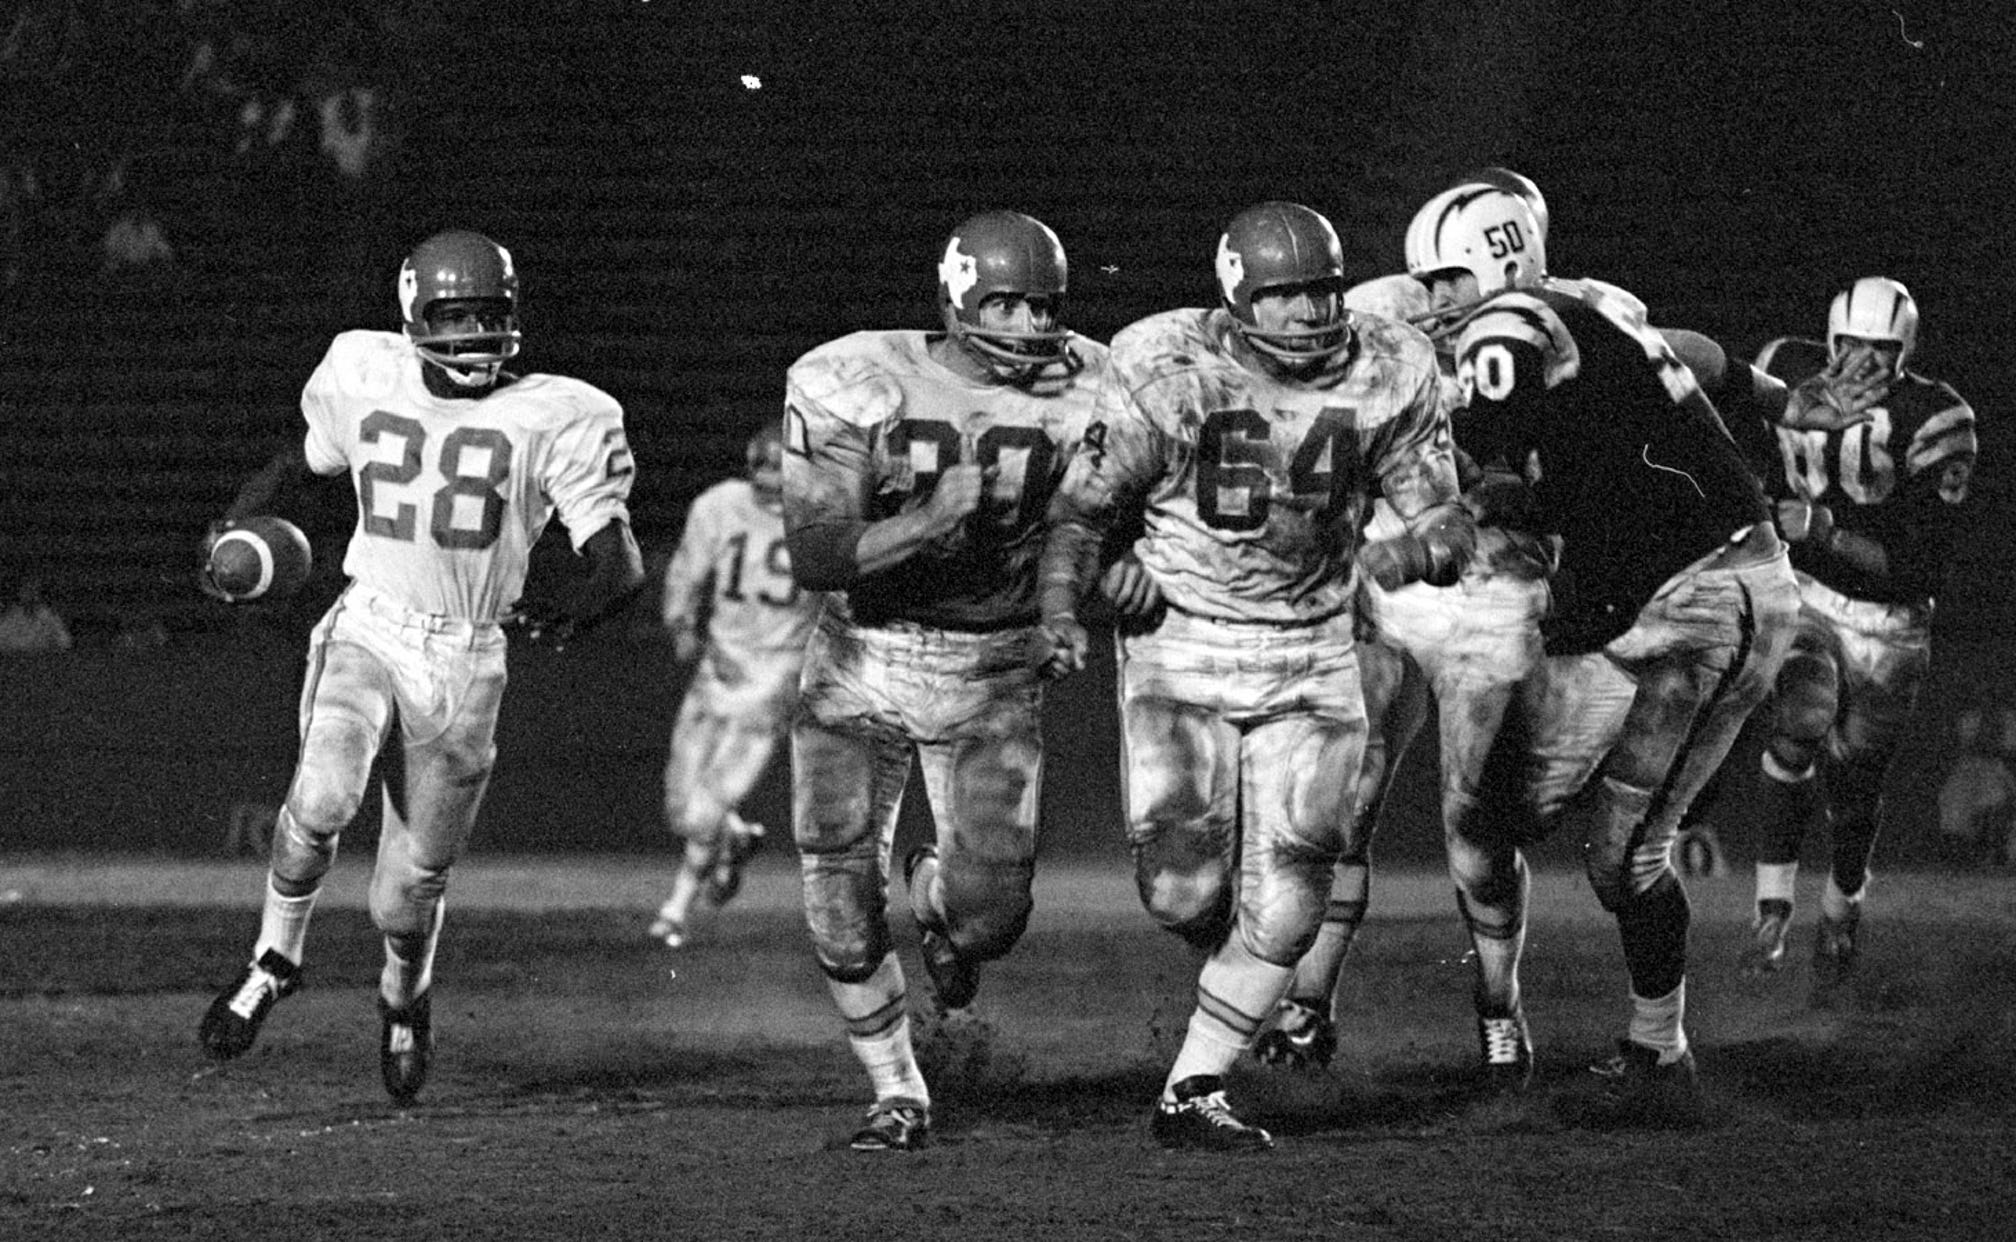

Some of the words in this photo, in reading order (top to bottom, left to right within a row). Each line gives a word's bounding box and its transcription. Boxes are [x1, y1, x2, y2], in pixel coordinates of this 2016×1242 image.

[1484, 221, 1525, 259] 50
[359, 409, 513, 551] 28
[1196, 407, 1361, 532] 64
[724, 531, 800, 608] 19
